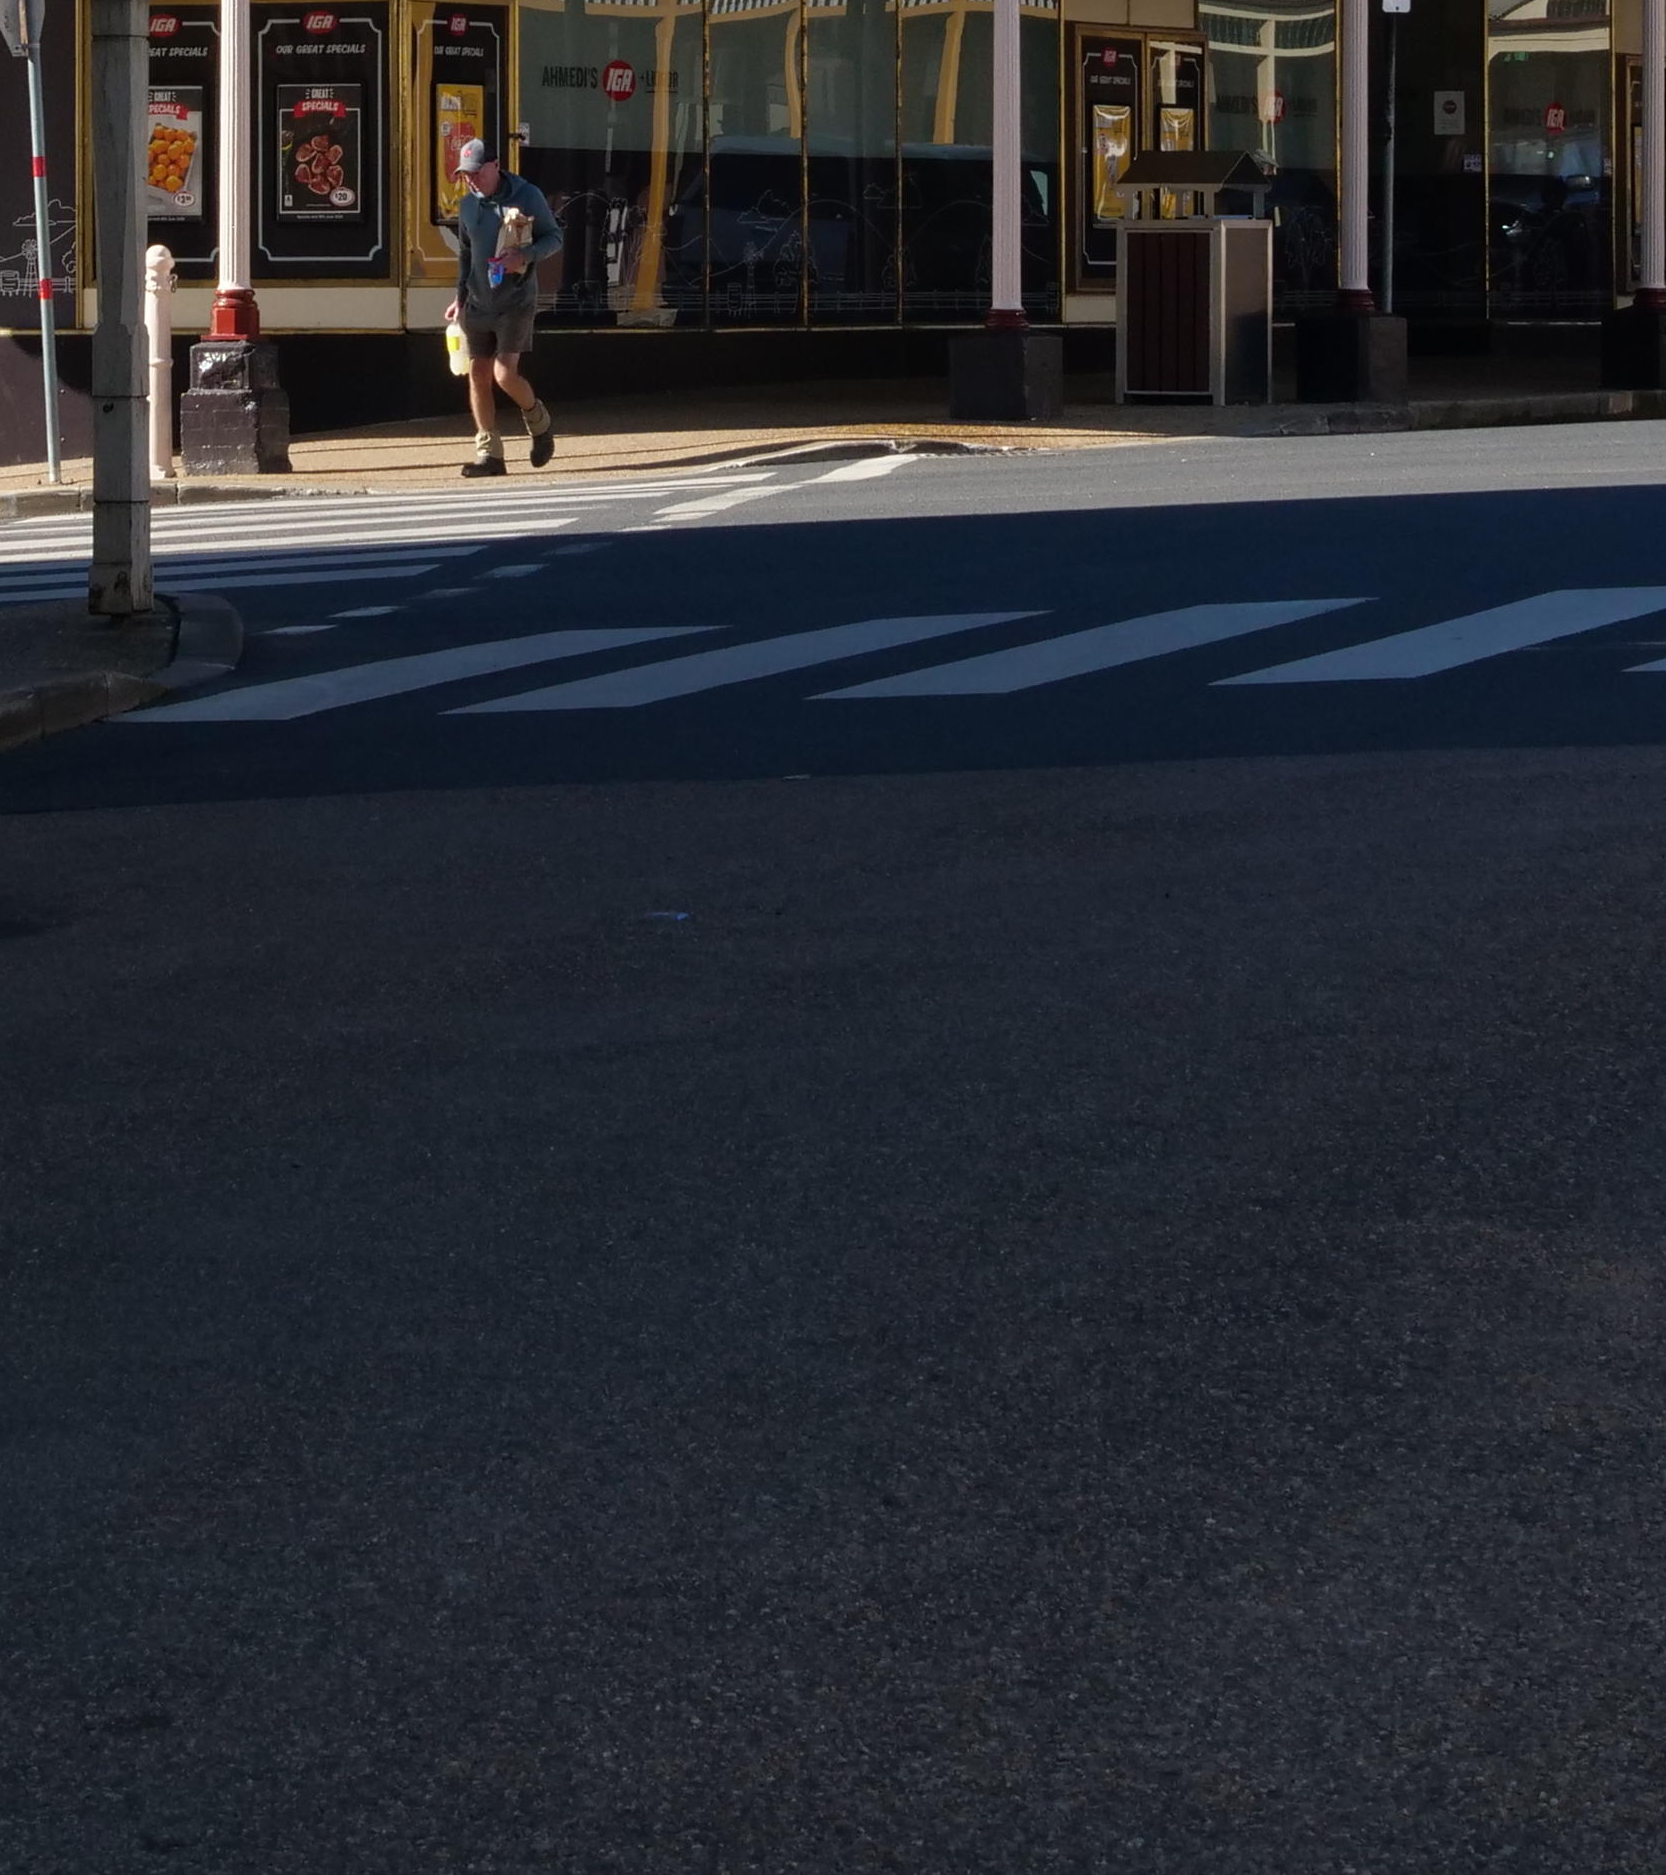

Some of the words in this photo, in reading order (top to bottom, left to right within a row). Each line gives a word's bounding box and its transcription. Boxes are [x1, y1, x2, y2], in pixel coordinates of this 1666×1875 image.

[150, 18, 177, 33] IGA
[306, 15, 334, 29] IGA
[149, 47, 166, 57] EAT
[168, 47, 208, 57] SPECIALS
[275, 45, 293, 55] OUR
[295, 44, 324, 55] GREAT
[326, 44, 366, 54] SPECIALS
[541, 66, 598, 89] AHMEDI'S
[606, 68, 633, 92] IGA
[149, 103, 181, 115] PECIALS
[301, 101, 339, 112] SPECIALS
